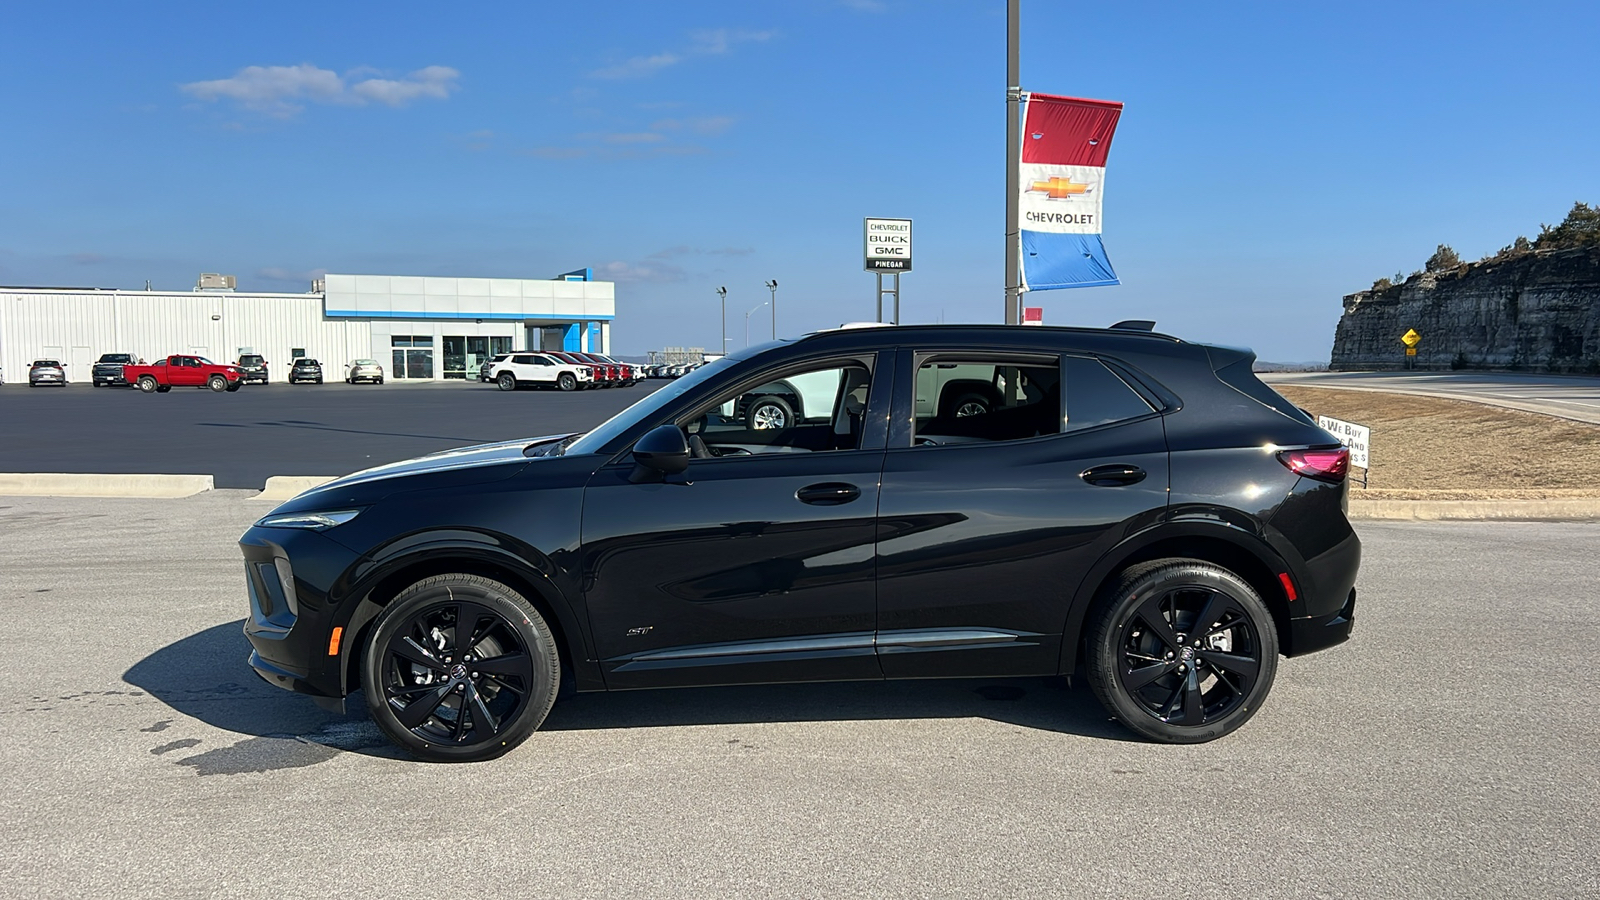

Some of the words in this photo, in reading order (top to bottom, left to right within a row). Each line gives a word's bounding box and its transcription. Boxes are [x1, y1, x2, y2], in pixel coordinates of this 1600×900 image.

[1026, 211, 1093, 224] CHEVROLET
[870, 223, 908, 231] CHEVROLET
[869, 235, 908, 243] BUICK
